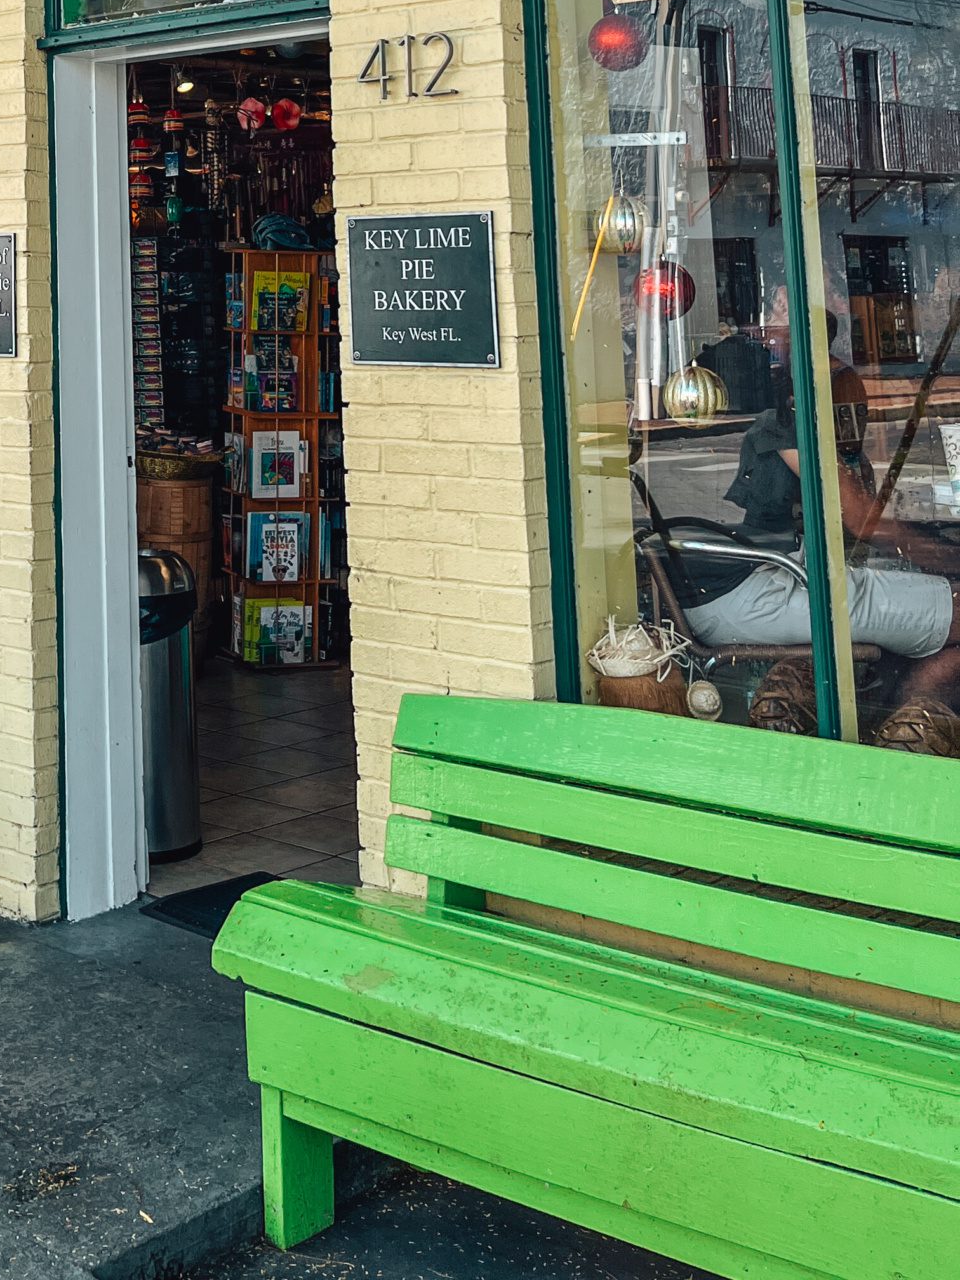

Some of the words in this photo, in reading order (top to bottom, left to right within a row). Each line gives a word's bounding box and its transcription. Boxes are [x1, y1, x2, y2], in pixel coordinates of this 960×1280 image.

[357, 32, 459, 100] 412
[364, 229, 409, 250] KEY
[414, 227, 472, 249] LIME
[400, 259, 436, 280] PIE
[373, 290, 466, 312] BAKERY
[382, 327, 406, 343] Key
[408, 328, 438, 342] West
[440, 327, 462, 342] FL.
